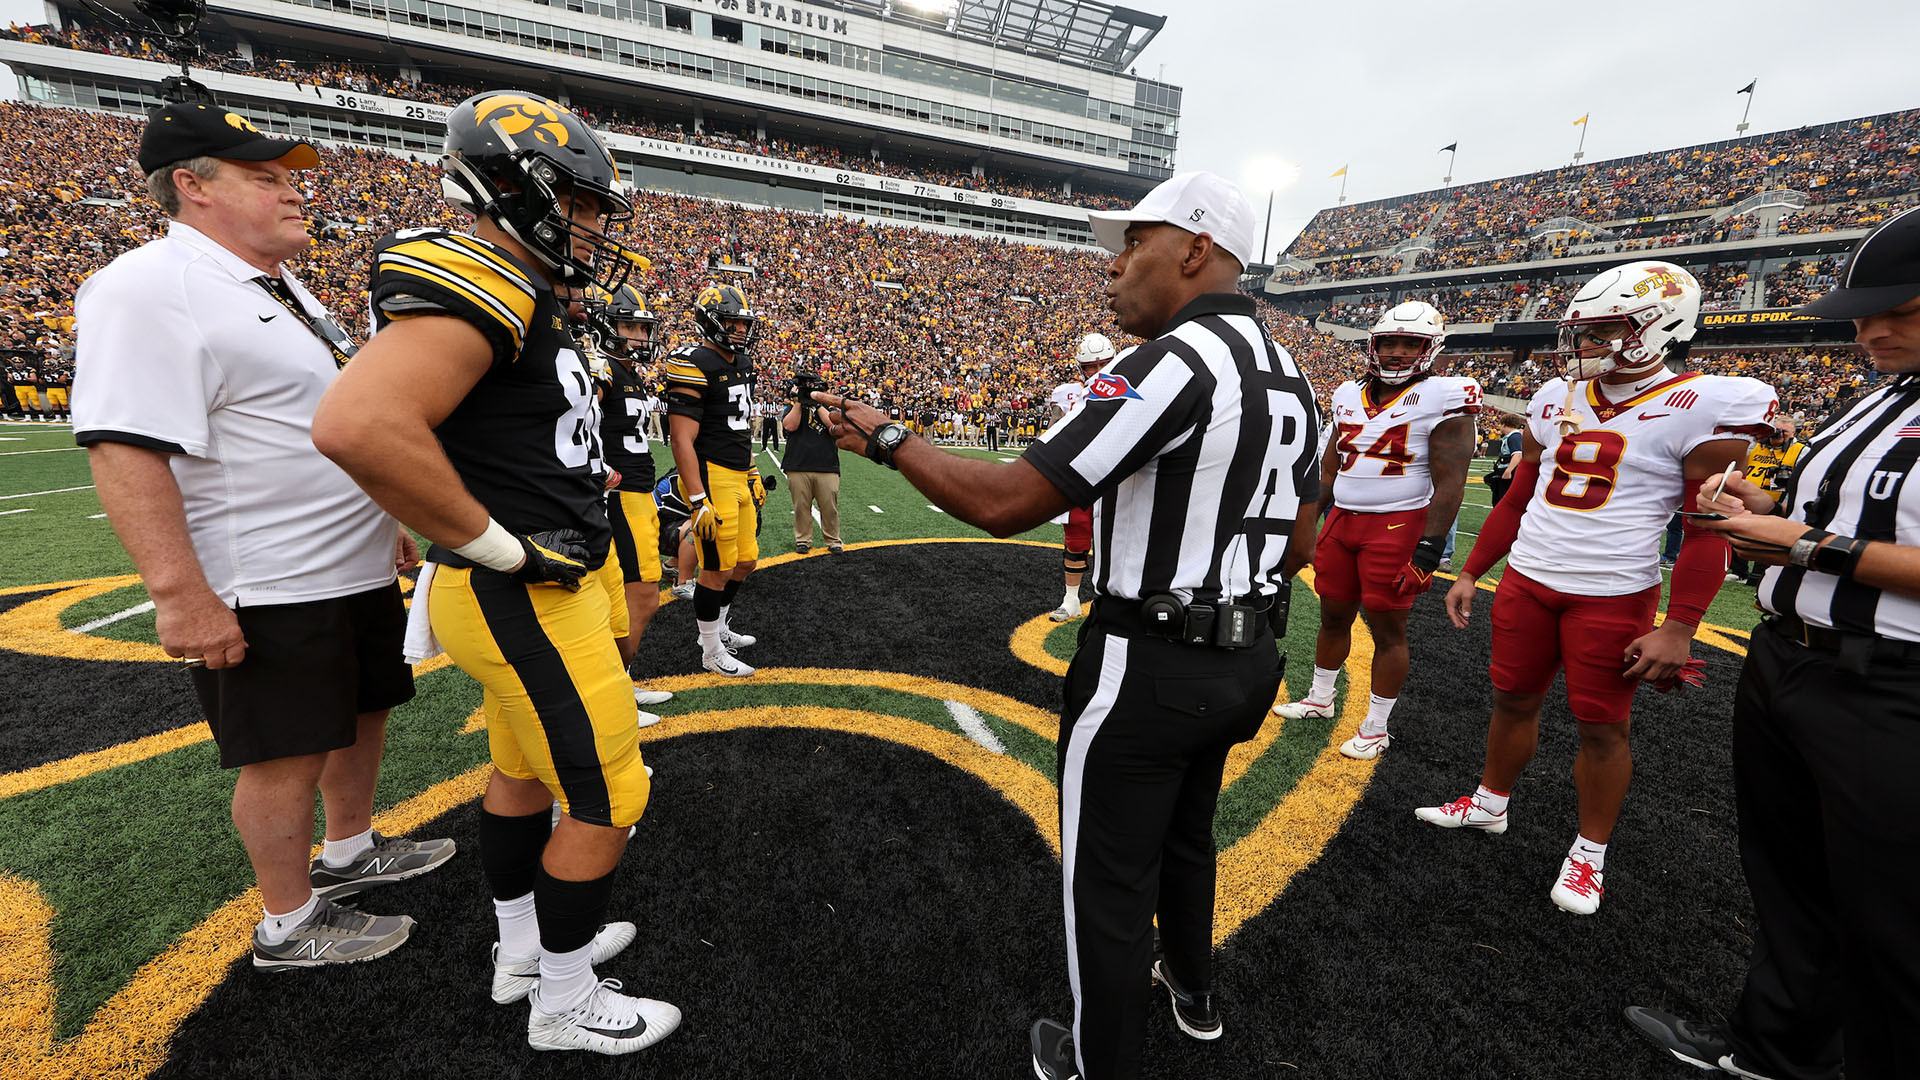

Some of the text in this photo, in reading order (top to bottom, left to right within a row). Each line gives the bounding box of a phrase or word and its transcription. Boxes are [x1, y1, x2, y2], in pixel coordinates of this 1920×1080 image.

[746, 0, 847, 35] STADIUM
[336, 94, 357, 109] 36
[359, 98, 377, 106] Larry
[360, 104, 385, 113] Station
[405, 105, 425, 119] 25
[427, 108, 447, 117] Randy
[640, 140, 669, 151] PAUL
[689, 148, 748, 163] BRECHLER
[755, 159, 789, 170] PRESS
[797, 164, 817, 174] BOX
[836, 173, 850, 184] 62
[879, 180, 884, 189] 1
[913, 185, 926, 196] 77
[953, 191, 965, 202] 16
[991, 197, 1004, 208] 99
[1703, 311, 1822, 325] GAME SPON
[555, 347, 593, 469] 8
[1541, 404, 1555, 420] C
[622, 397, 651, 454] 3
[1243, 388, 1308, 521] R
[1337, 422, 1416, 477] 34
[1544, 429, 1627, 512] 8
[1868, 470, 1904, 500] U
